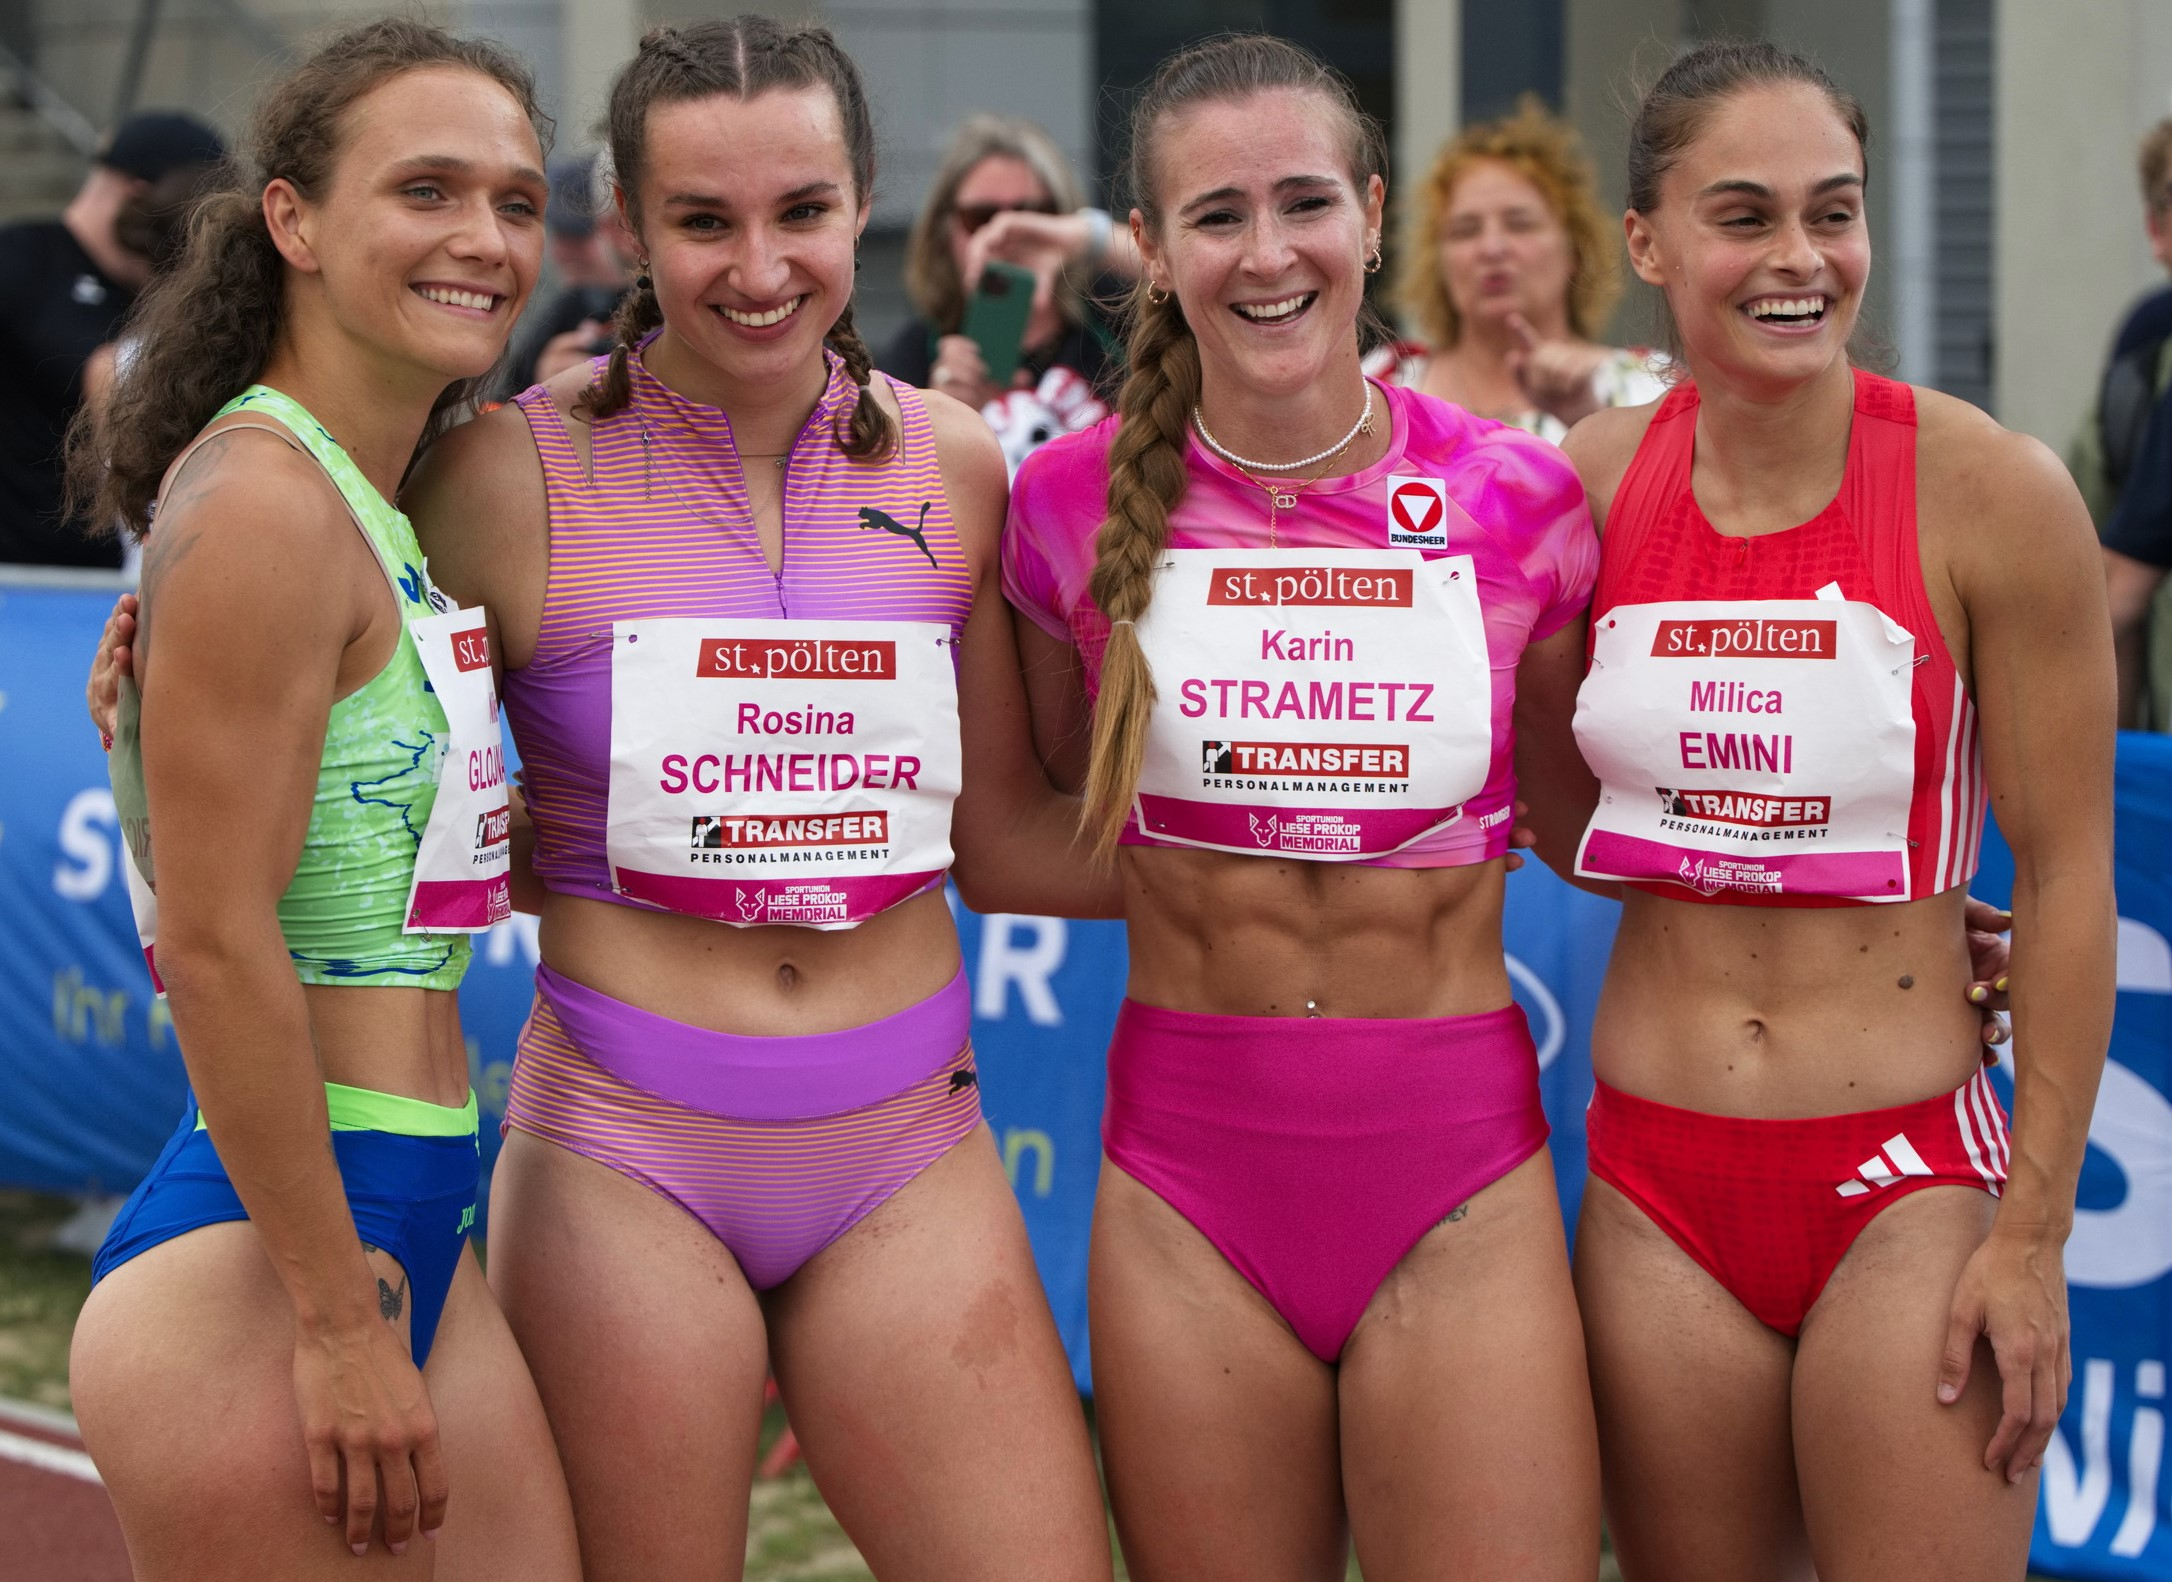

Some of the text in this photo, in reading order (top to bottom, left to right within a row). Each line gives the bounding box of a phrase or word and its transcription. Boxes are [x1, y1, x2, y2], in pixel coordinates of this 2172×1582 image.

[1391, 533, 1445, 545] BUNDESHEER
[1261, 629, 1354, 661] Karin
[1179, 678, 1435, 722] STRAMETZ
[1689, 680, 1783, 714] Milica
[737, 702, 855, 735] Rosina
[1236, 746, 1403, 773] TRANSFER
[1679, 731, 1793, 774] EMINI
[660, 754, 921, 794] SCHNEIDER
[1203, 778, 1410, 794] PERSONALMANAGEMENT
[1684, 795, 1826, 822] TRANSFER
[1296, 815, 1344, 824] SPORTUNION
[726, 816, 883, 844] TRANSFER
[1279, 822, 1361, 836] LIESE PROKOP
[1660, 818, 1828, 842] PERSONALMANAGEMENT
[1281, 835, 1359, 851] MEMORIAL
[690, 848, 890, 864] PERSONALMANAGEMENT
[1703, 866, 1782, 883] LIESE PROKOP
[1719, 860, 1765, 872] SPORTUNION
[785, 885, 830, 894] SPORTUNION
[767, 892, 847, 905] LIESE PROKOP
[769, 906, 845, 921] MEMORIAL
